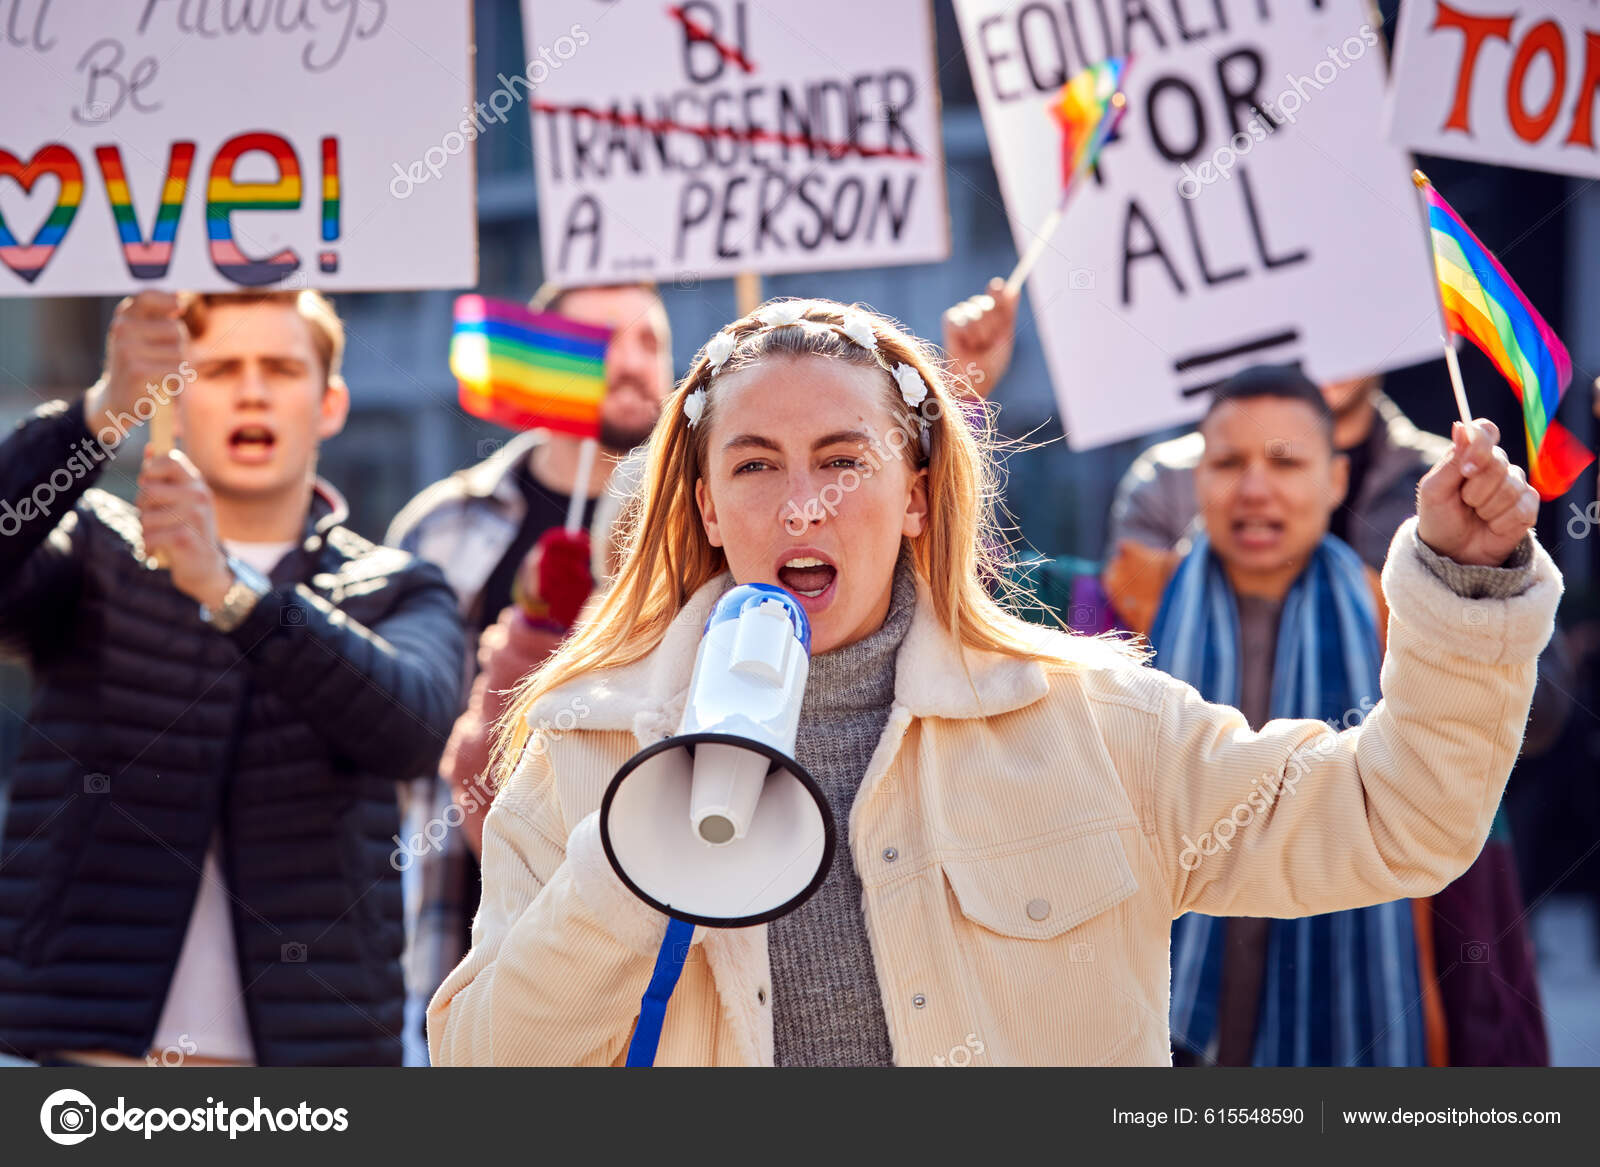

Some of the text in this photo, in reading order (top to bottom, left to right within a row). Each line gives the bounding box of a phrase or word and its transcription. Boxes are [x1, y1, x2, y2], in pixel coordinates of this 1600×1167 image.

[70, 37, 164, 127] Be
[534, 70, 921, 181] TRANSGENDER
[1090, 47, 1282, 188] OR
[1428, 0, 1600, 150] TO
[673, 173, 919, 264] PERSON
[1119, 166, 1308, 305] ALL
